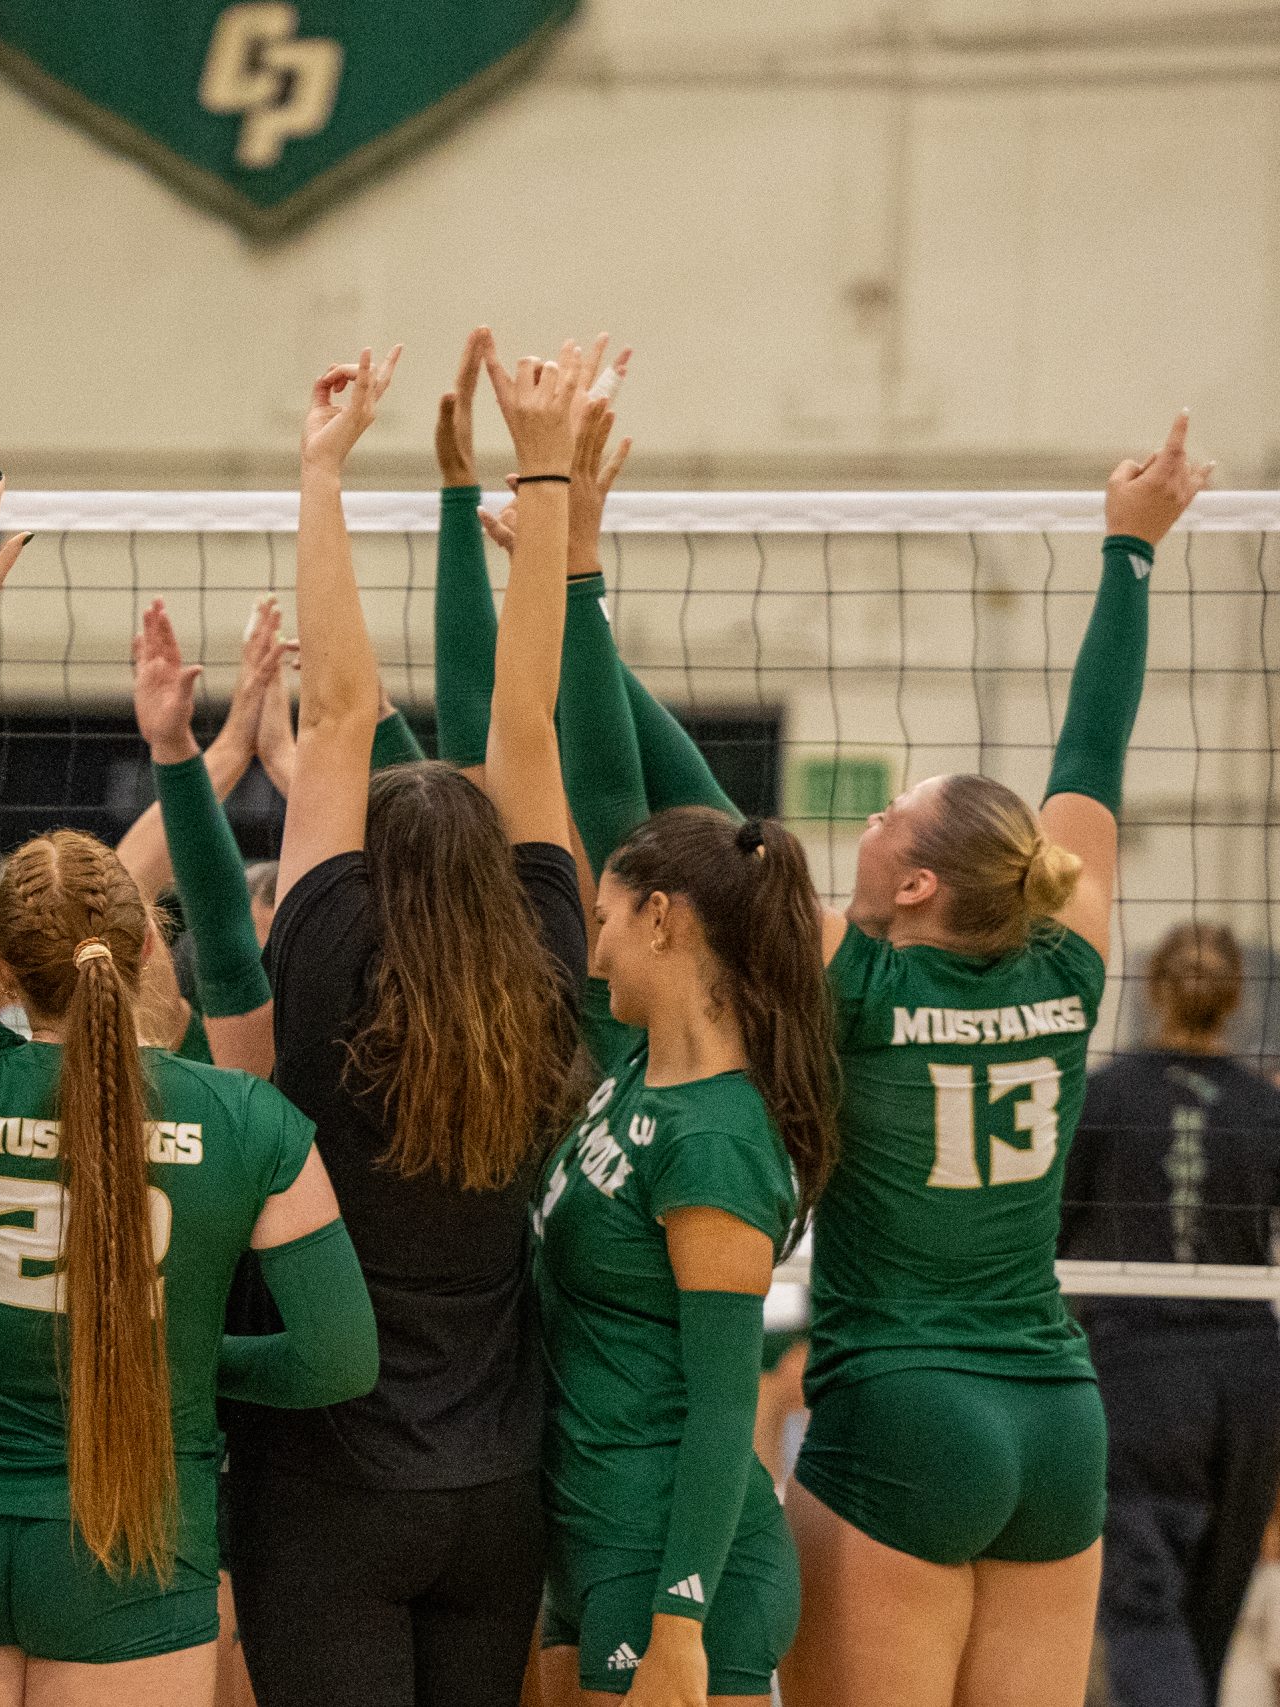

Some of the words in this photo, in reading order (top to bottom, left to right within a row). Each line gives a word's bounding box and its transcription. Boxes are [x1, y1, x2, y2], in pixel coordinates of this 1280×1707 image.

[198, 3, 345, 168] CP
[890, 995, 1087, 1046] MUSTANGS
[926, 1056, 1064, 1189] 13
